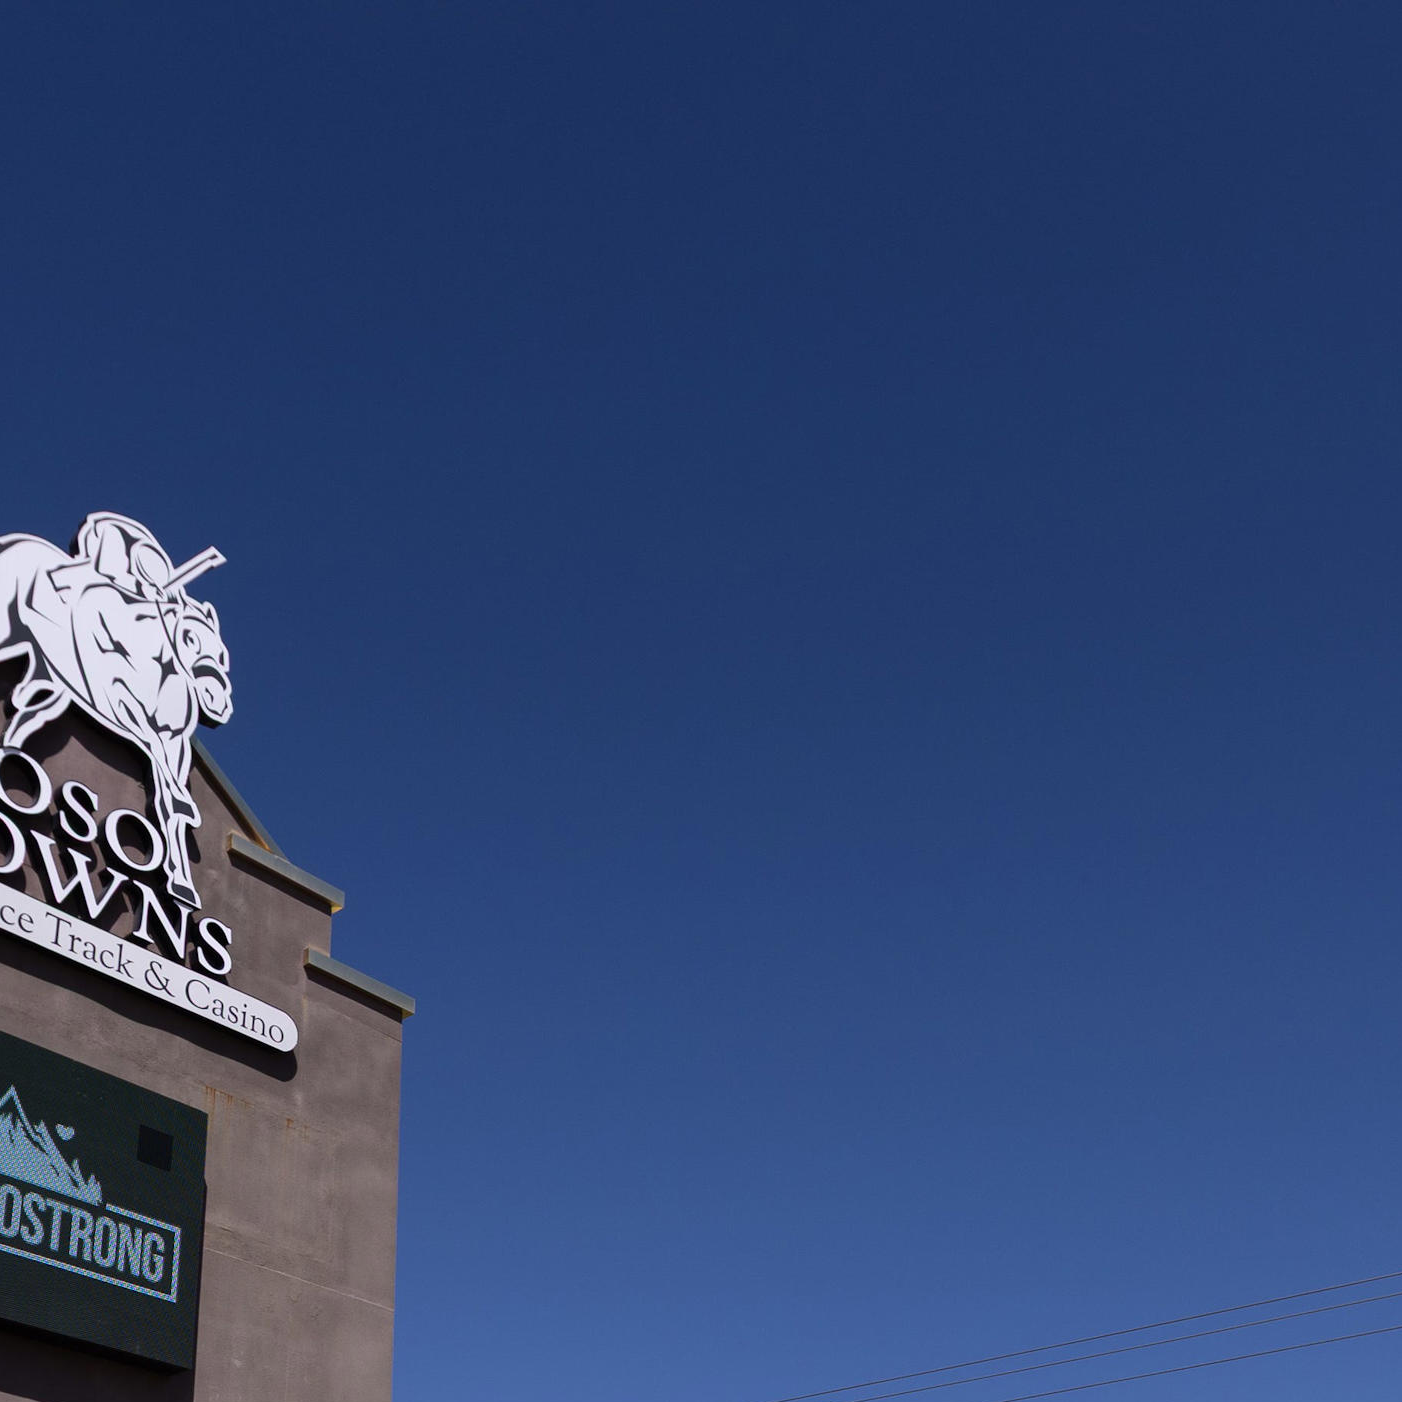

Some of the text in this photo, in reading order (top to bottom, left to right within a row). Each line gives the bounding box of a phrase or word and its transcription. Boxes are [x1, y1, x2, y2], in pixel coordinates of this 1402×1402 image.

[45, 911, 134, 980] Track
[144, 961, 176, 999] &
[185, 979, 285, 1044] Casino
